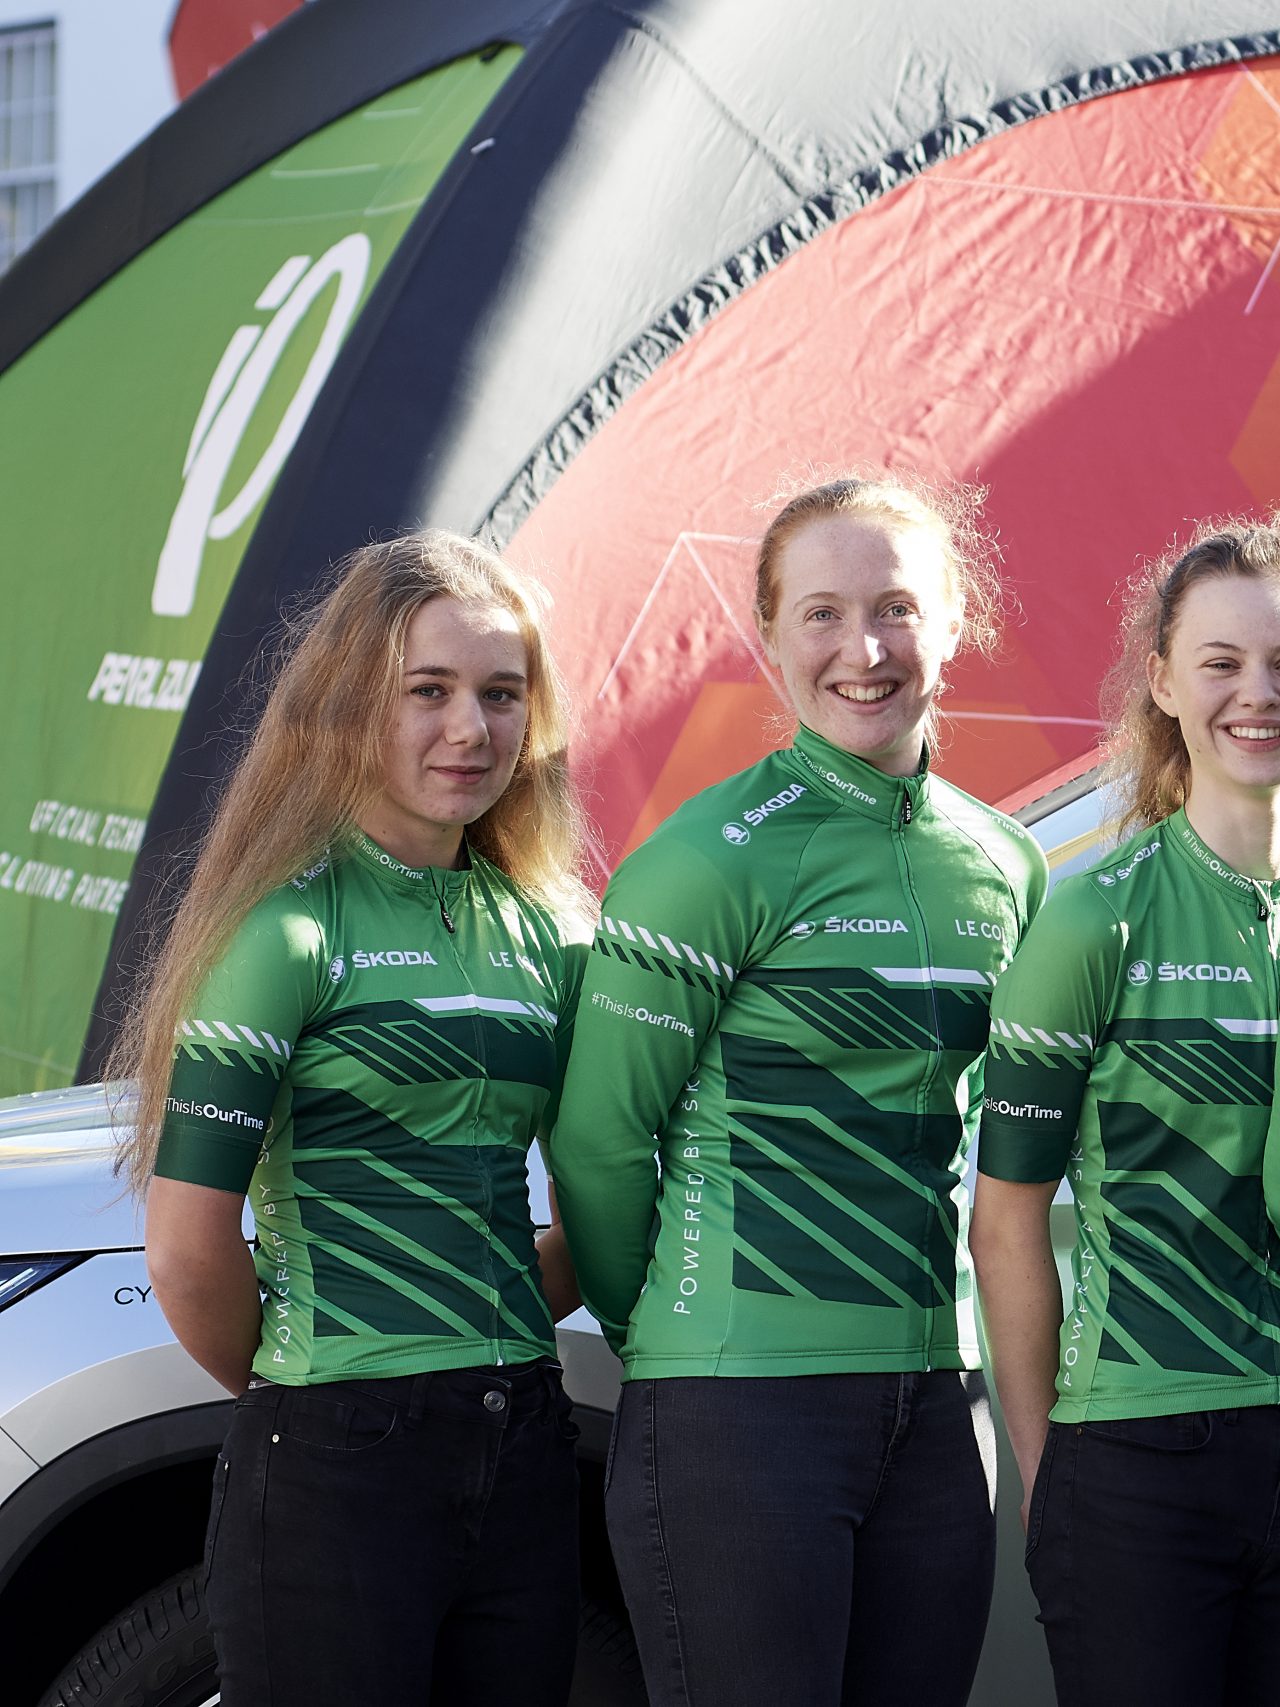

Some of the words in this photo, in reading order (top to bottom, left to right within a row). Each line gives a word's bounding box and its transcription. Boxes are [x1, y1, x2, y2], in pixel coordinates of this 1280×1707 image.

[743, 783, 808, 827] ŠKODA
[350, 831, 424, 879] ThisIsOurTime
[1182, 829, 1255, 893] #ThisIsOurTime
[823, 916, 909, 933] ŠKODA
[955, 919, 979, 937] LE
[352, 949, 438, 968] ŠKODA
[488, 951, 514, 968] LE
[1157, 962, 1252, 983] ŠKODA
[591, 991, 695, 1038] #ThisIsOurTime
[163, 1097, 264, 1131] ThisIsOurTime
[683, 1128, 700, 1158] BY
[673, 1173, 704, 1315] POWERED
